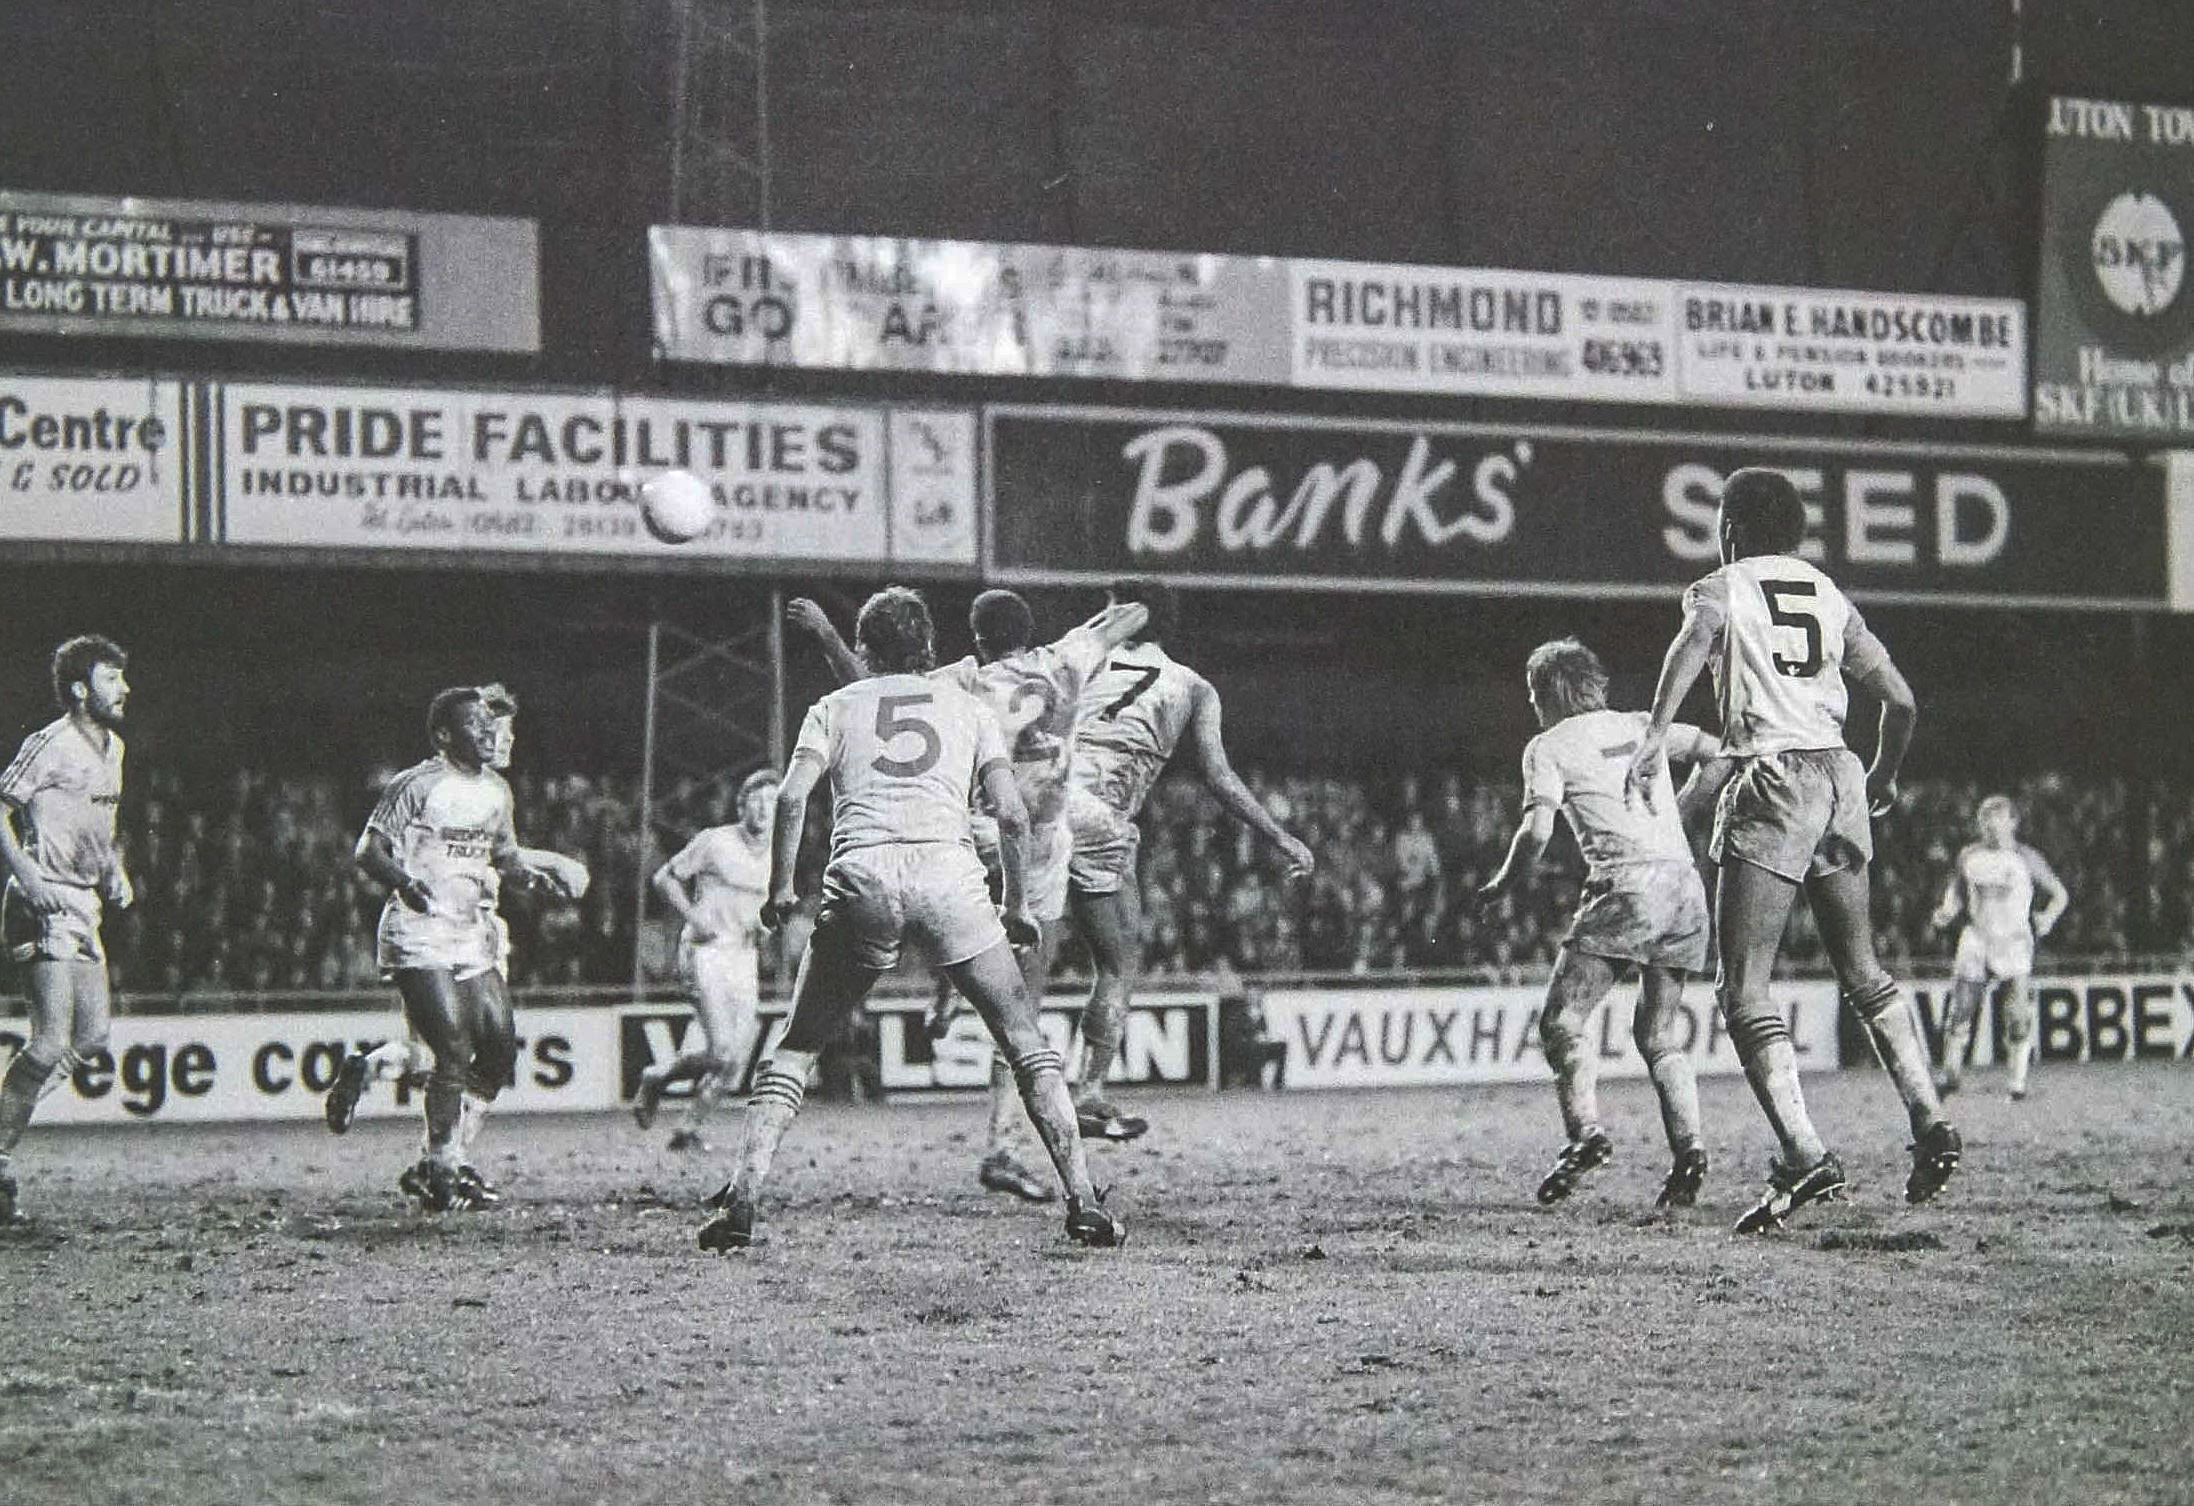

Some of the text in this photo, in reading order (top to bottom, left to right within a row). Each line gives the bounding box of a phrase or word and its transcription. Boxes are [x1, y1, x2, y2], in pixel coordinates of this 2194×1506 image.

[6, 279, 84, 312] LONG
[92, 282, 173, 316] TERM
[180, 286, 270, 321] TRUCK
[290, 291, 344, 325] VAN
[1306, 277, 1562, 335] RICHMOND
[1686, 298, 1774, 335] BRIAN
[1810, 304, 2011, 349] HANDSCOMBE
[1744, 367, 1836, 392] LUTON
[0, 396, 166, 451] Centre
[241, 403, 860, 475] PRIDE FACILITIES
[50, 462, 141, 493] SOLD
[241, 467, 487, 501] INDUSTRIAL
[516, 474, 648, 507] LABOU
[1758, 579, 1823, 678] 5
[1100, 659, 1161, 723] 7
[870, 693, 942, 779] 5
[1008, 678, 1062, 764] 2
